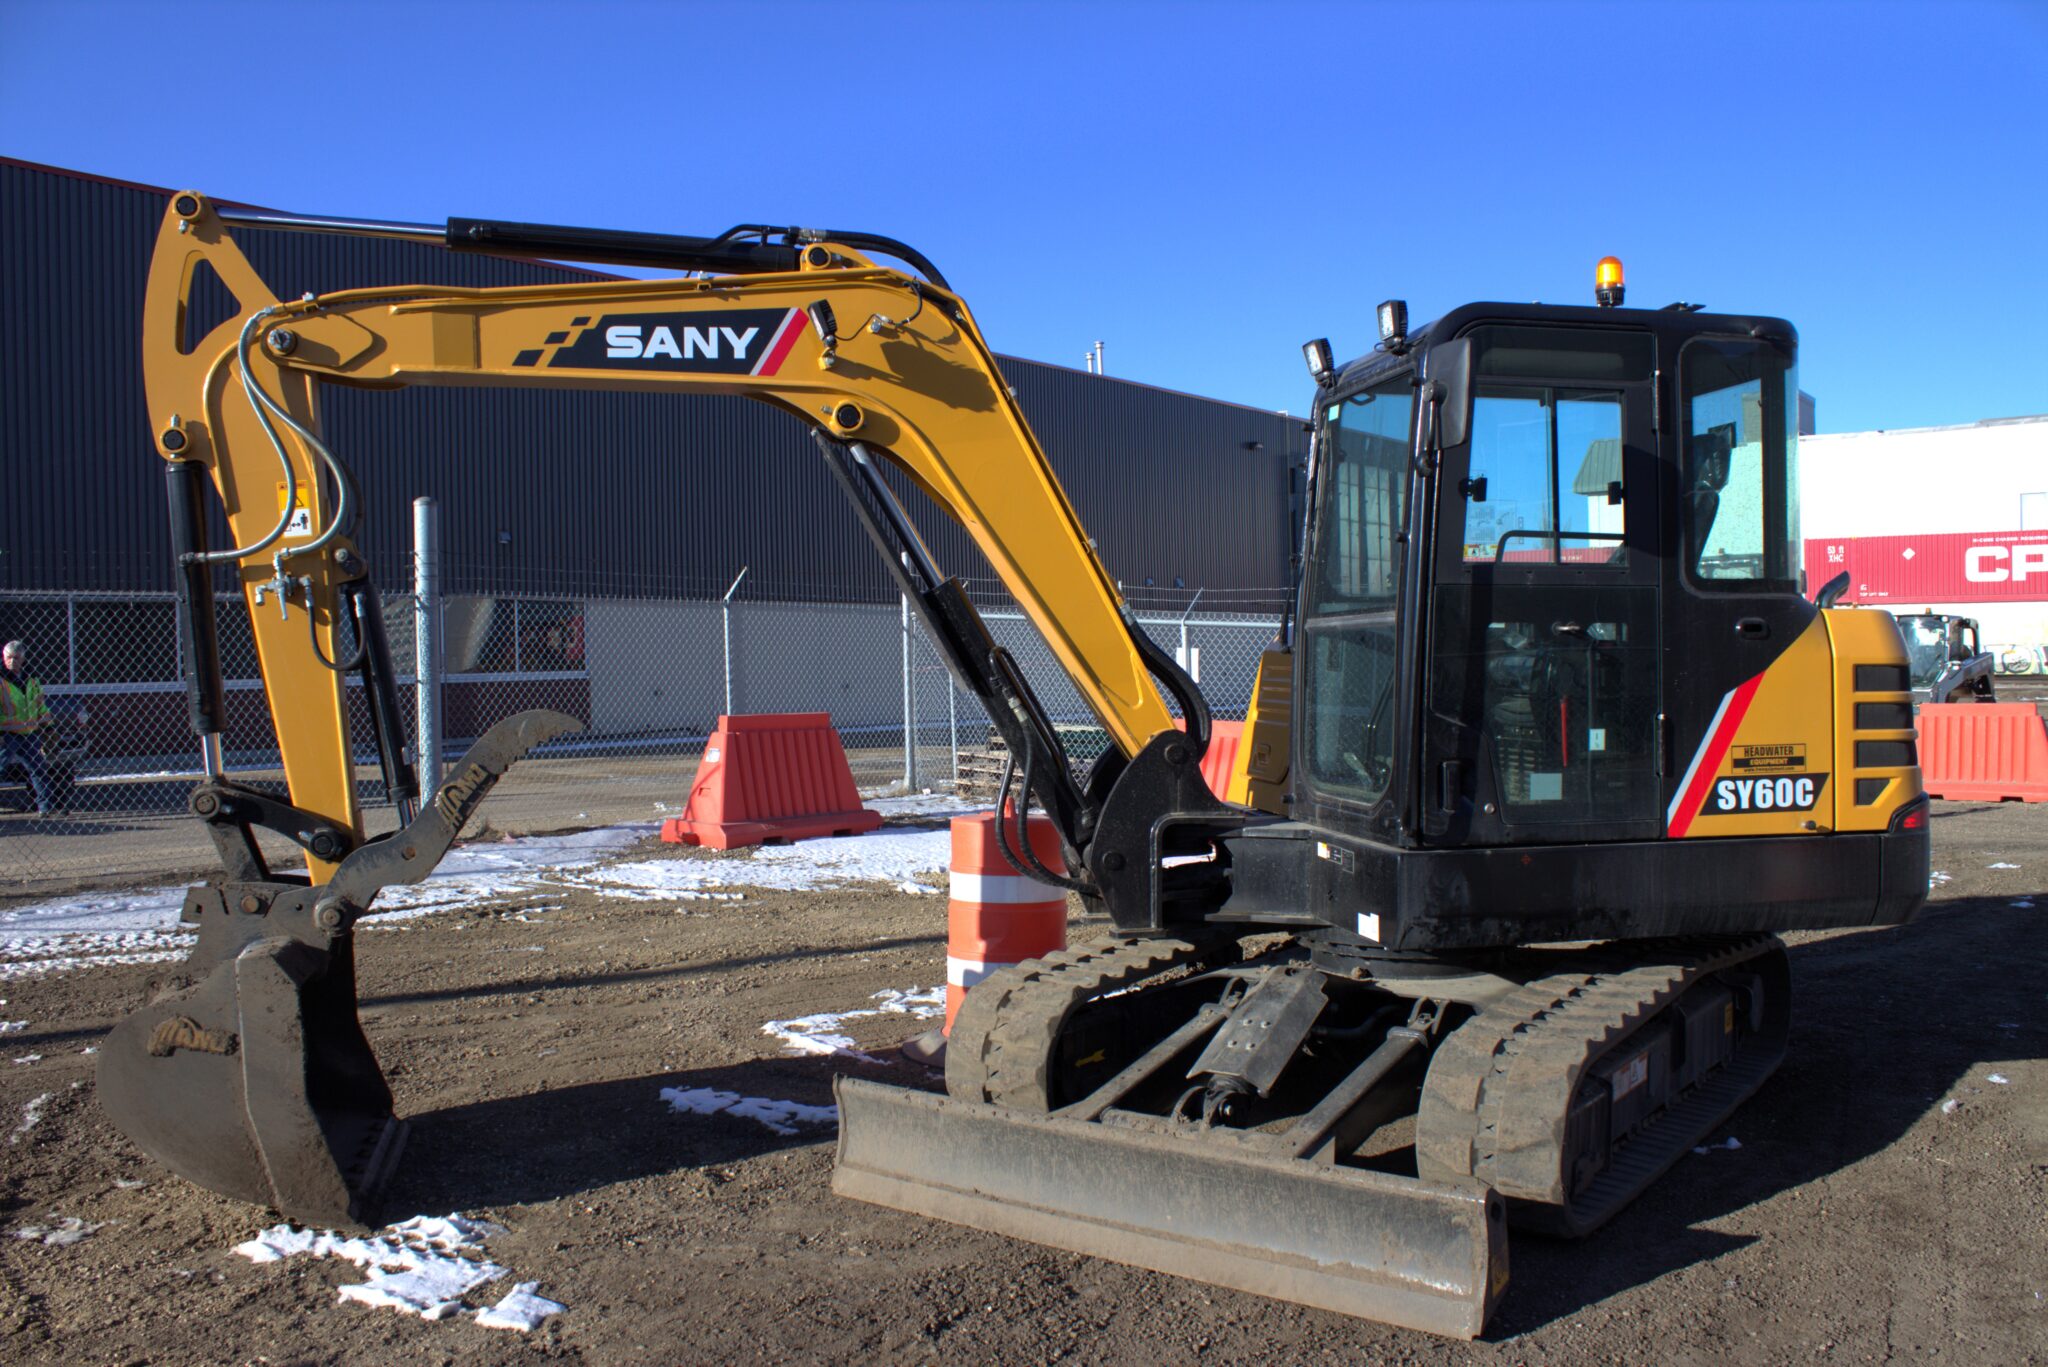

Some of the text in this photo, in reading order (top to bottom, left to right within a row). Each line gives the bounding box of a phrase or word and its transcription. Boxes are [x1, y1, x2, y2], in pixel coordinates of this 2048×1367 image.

[605, 326, 759, 359] SANY
[1827, 545, 1836, 554] 53
[1828, 553, 1844, 563] XHC
[1965, 545, 2048, 582] CP
[1744, 746, 1794, 757] HEADWATER
[1750, 758, 1788, 766] EQUIPMENT
[1717, 778, 1814, 810] SY60C
